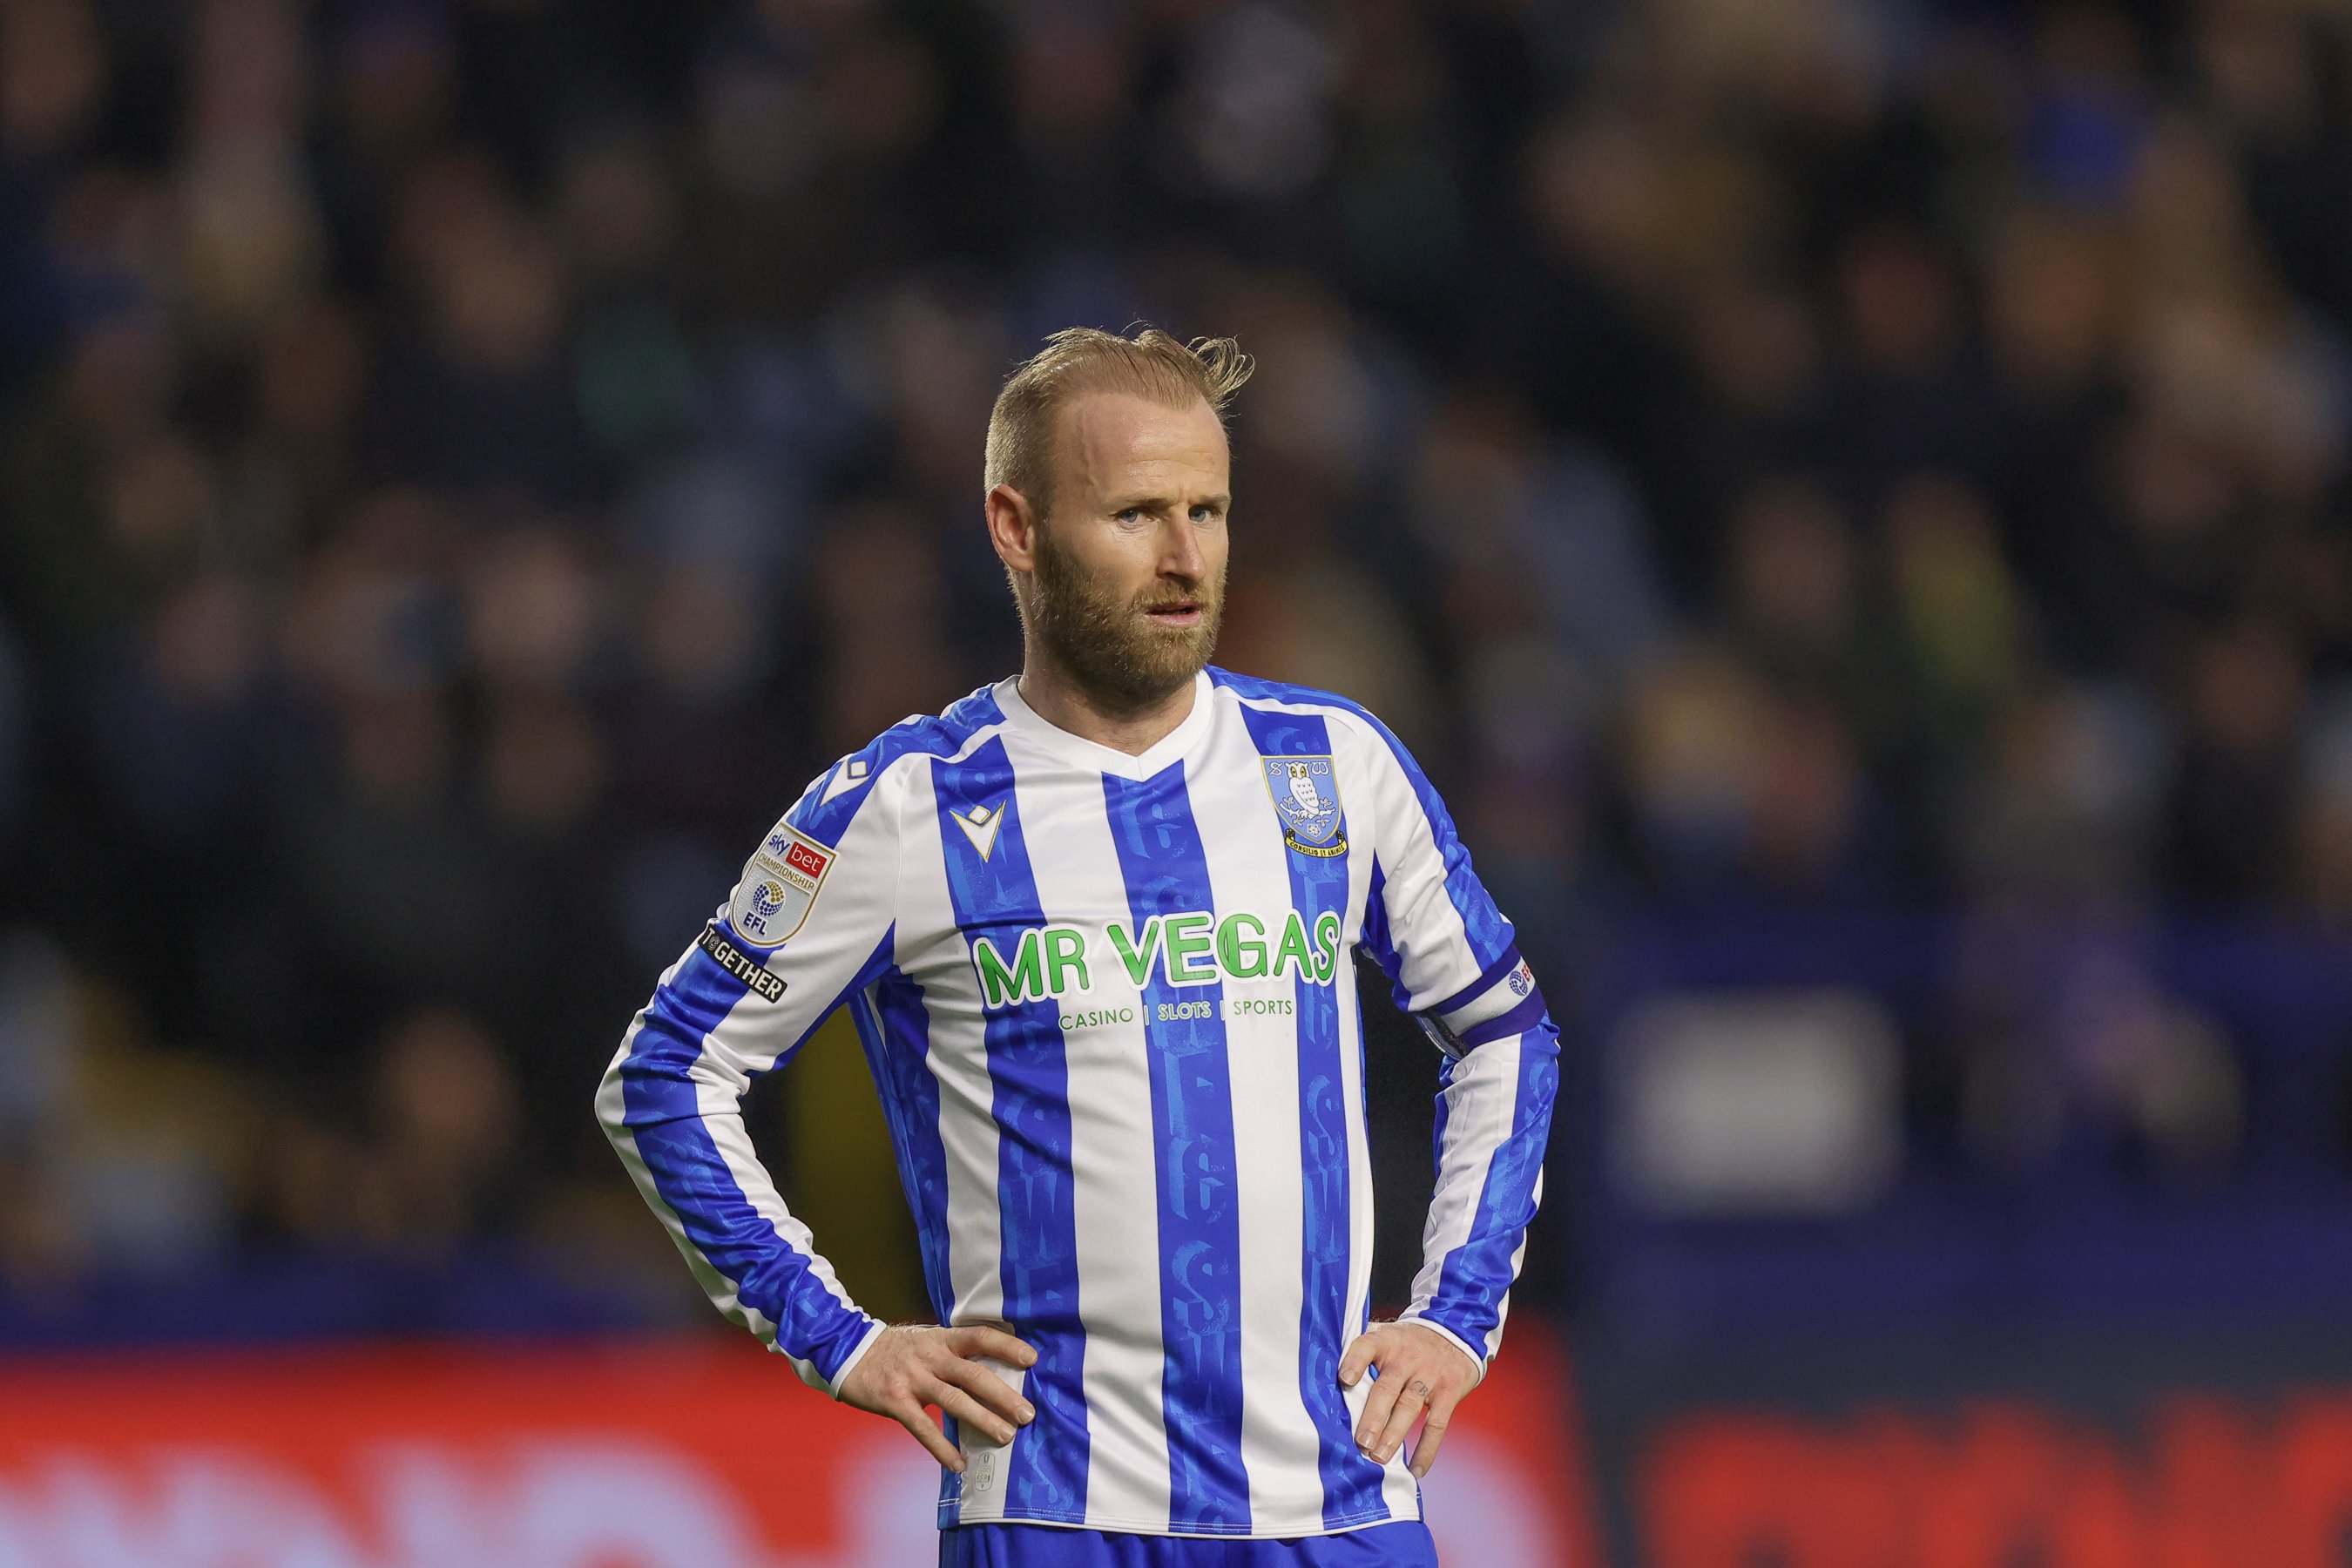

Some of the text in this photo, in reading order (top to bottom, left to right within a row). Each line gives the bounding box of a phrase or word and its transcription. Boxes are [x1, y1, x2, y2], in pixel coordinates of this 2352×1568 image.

[768, 833, 822, 873] sky bet
[1289, 841, 1319, 855] CONSILIO
[757, 852, 815, 890] CHAMPIONSHIP
[742, 911, 767, 936] EFL
[976, 912, 1340, 1006] MR VEGAS
[1521, 963, 1531, 983] EF
[1058, 1000, 1294, 1031] CASINO SLOTS SPORTS
